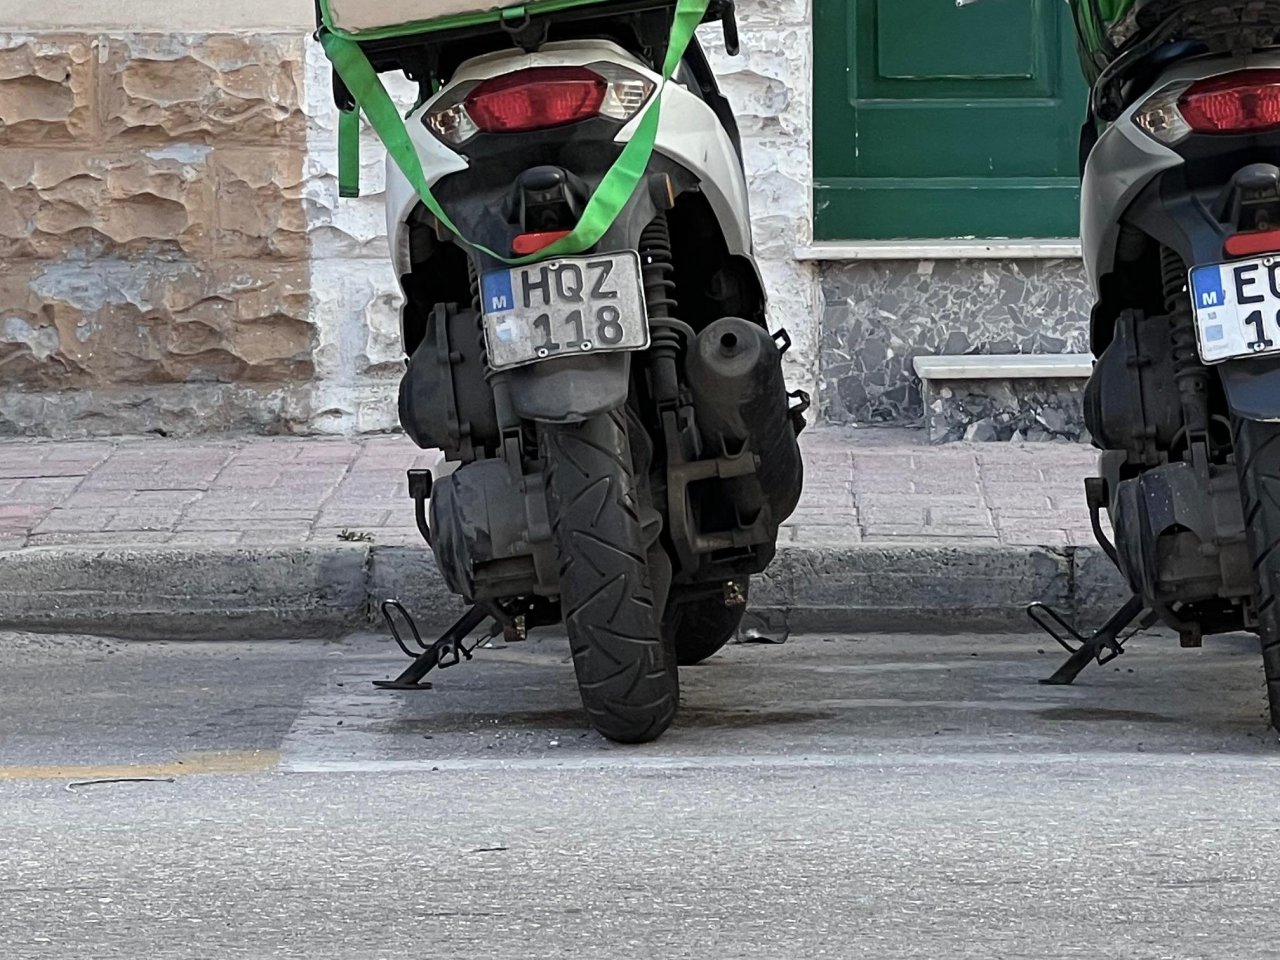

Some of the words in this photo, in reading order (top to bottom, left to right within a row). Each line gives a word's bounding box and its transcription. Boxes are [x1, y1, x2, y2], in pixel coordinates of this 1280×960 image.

[521, 260, 618, 308] HQZ
[1201, 290, 1218, 306] M
[492, 295, 508, 310] M
[532, 305, 624, 352] 118
